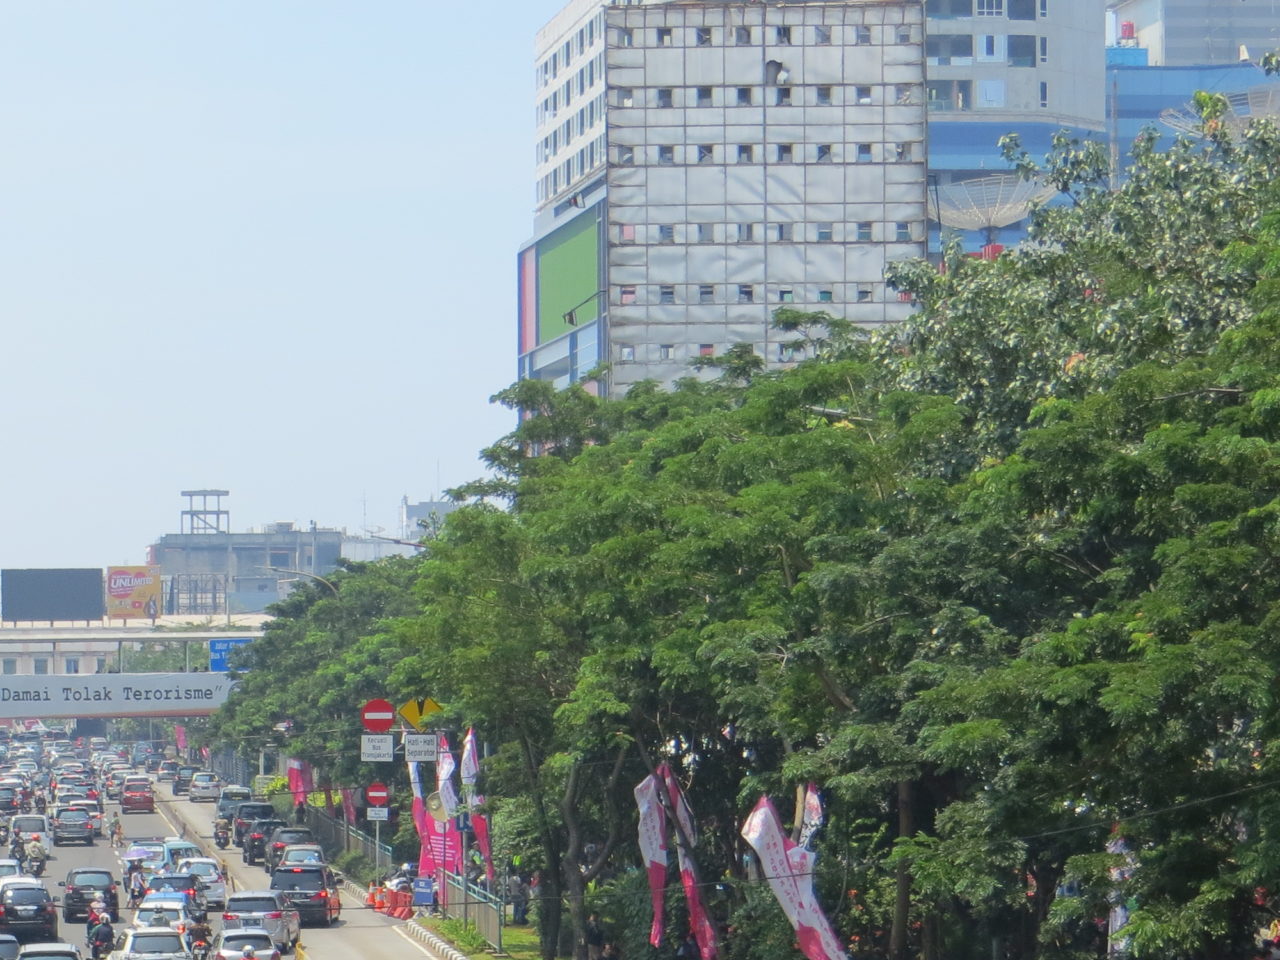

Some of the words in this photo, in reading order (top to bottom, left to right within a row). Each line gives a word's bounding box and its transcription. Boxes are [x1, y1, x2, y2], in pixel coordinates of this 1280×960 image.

[111, 577, 152, 588] UNLIMITED
[1, 687, 51, 701] Damai
[63, 686, 112, 701] Tolak
